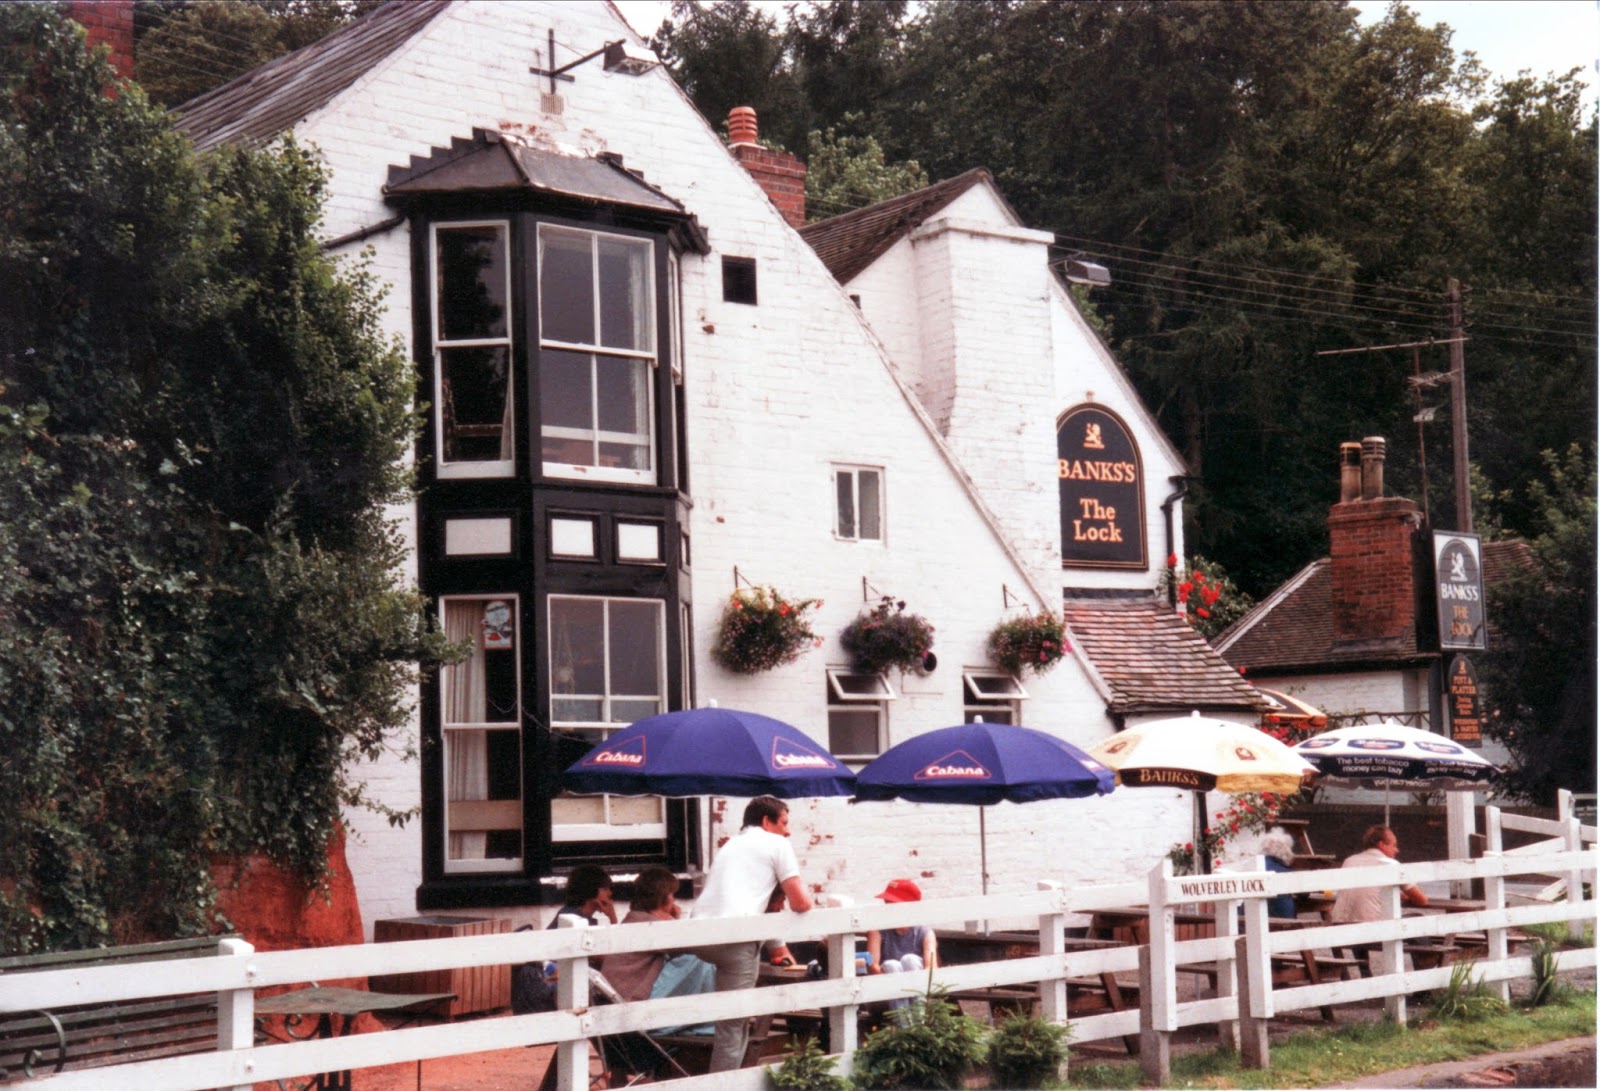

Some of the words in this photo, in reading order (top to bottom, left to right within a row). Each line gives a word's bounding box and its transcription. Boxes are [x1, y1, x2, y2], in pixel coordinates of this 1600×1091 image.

[1057, 459, 1136, 482] BANKS'S
[1080, 498, 1116, 519] The
[1073, 520, 1123, 542] Lock
[1452, 605, 1469, 619] THE
[595, 751, 643, 763] Cabana
[1375, 758, 1409, 767] tobacco
[925, 765, 985, 777] Cabana
[1388, 766, 1403, 774] buy
[1181, 880, 1238, 896] WOLVERLEY
[1241, 880, 1265, 893] LOCK
